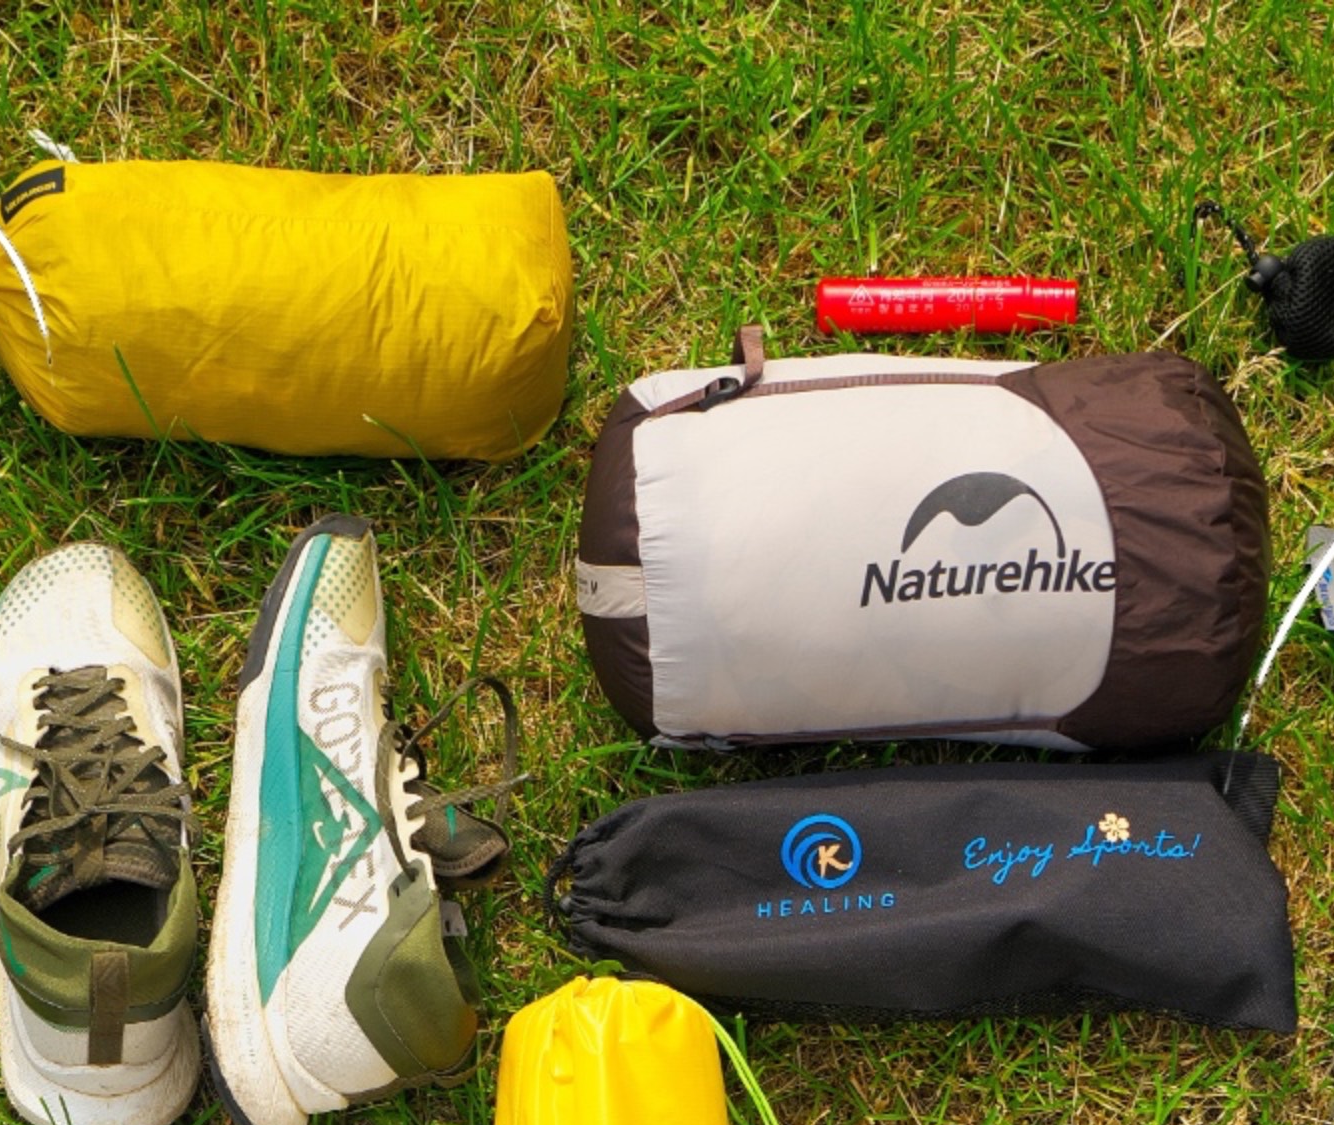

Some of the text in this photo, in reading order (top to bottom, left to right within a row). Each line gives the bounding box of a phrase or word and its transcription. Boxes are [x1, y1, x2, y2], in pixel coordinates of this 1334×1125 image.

[860, 549, 1117, 607] Naturehike
[964, 825, 1201, 884] Enjoy Sports!
[757, 893, 896, 918] HEALING
